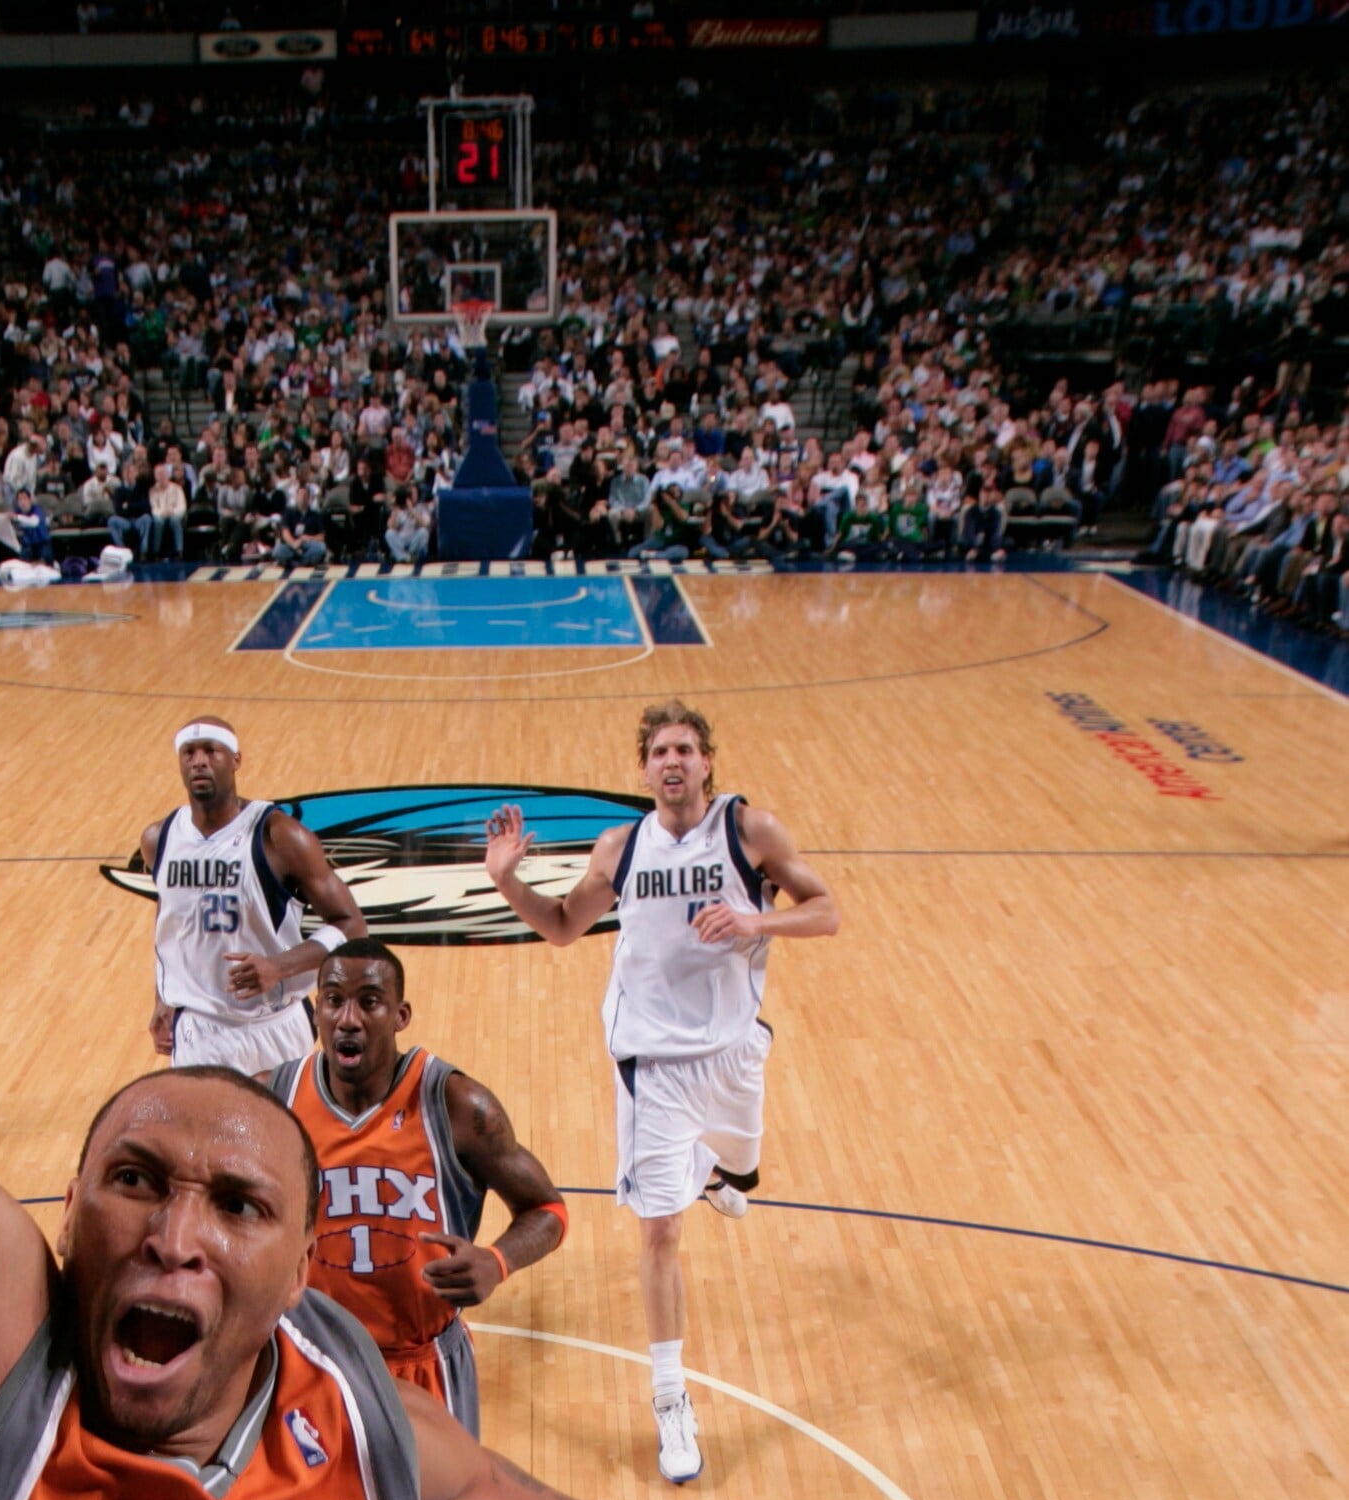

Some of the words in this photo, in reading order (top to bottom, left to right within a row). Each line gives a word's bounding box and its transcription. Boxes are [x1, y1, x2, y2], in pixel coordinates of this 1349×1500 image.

[456, 141, 500, 186] 21
[166, 858, 242, 888] DALLAS
[636, 863, 724, 900] DALLAS
[202, 893, 239, 933] 25
[319, 1165, 437, 1222] HX
[349, 1224, 375, 1274] 1
